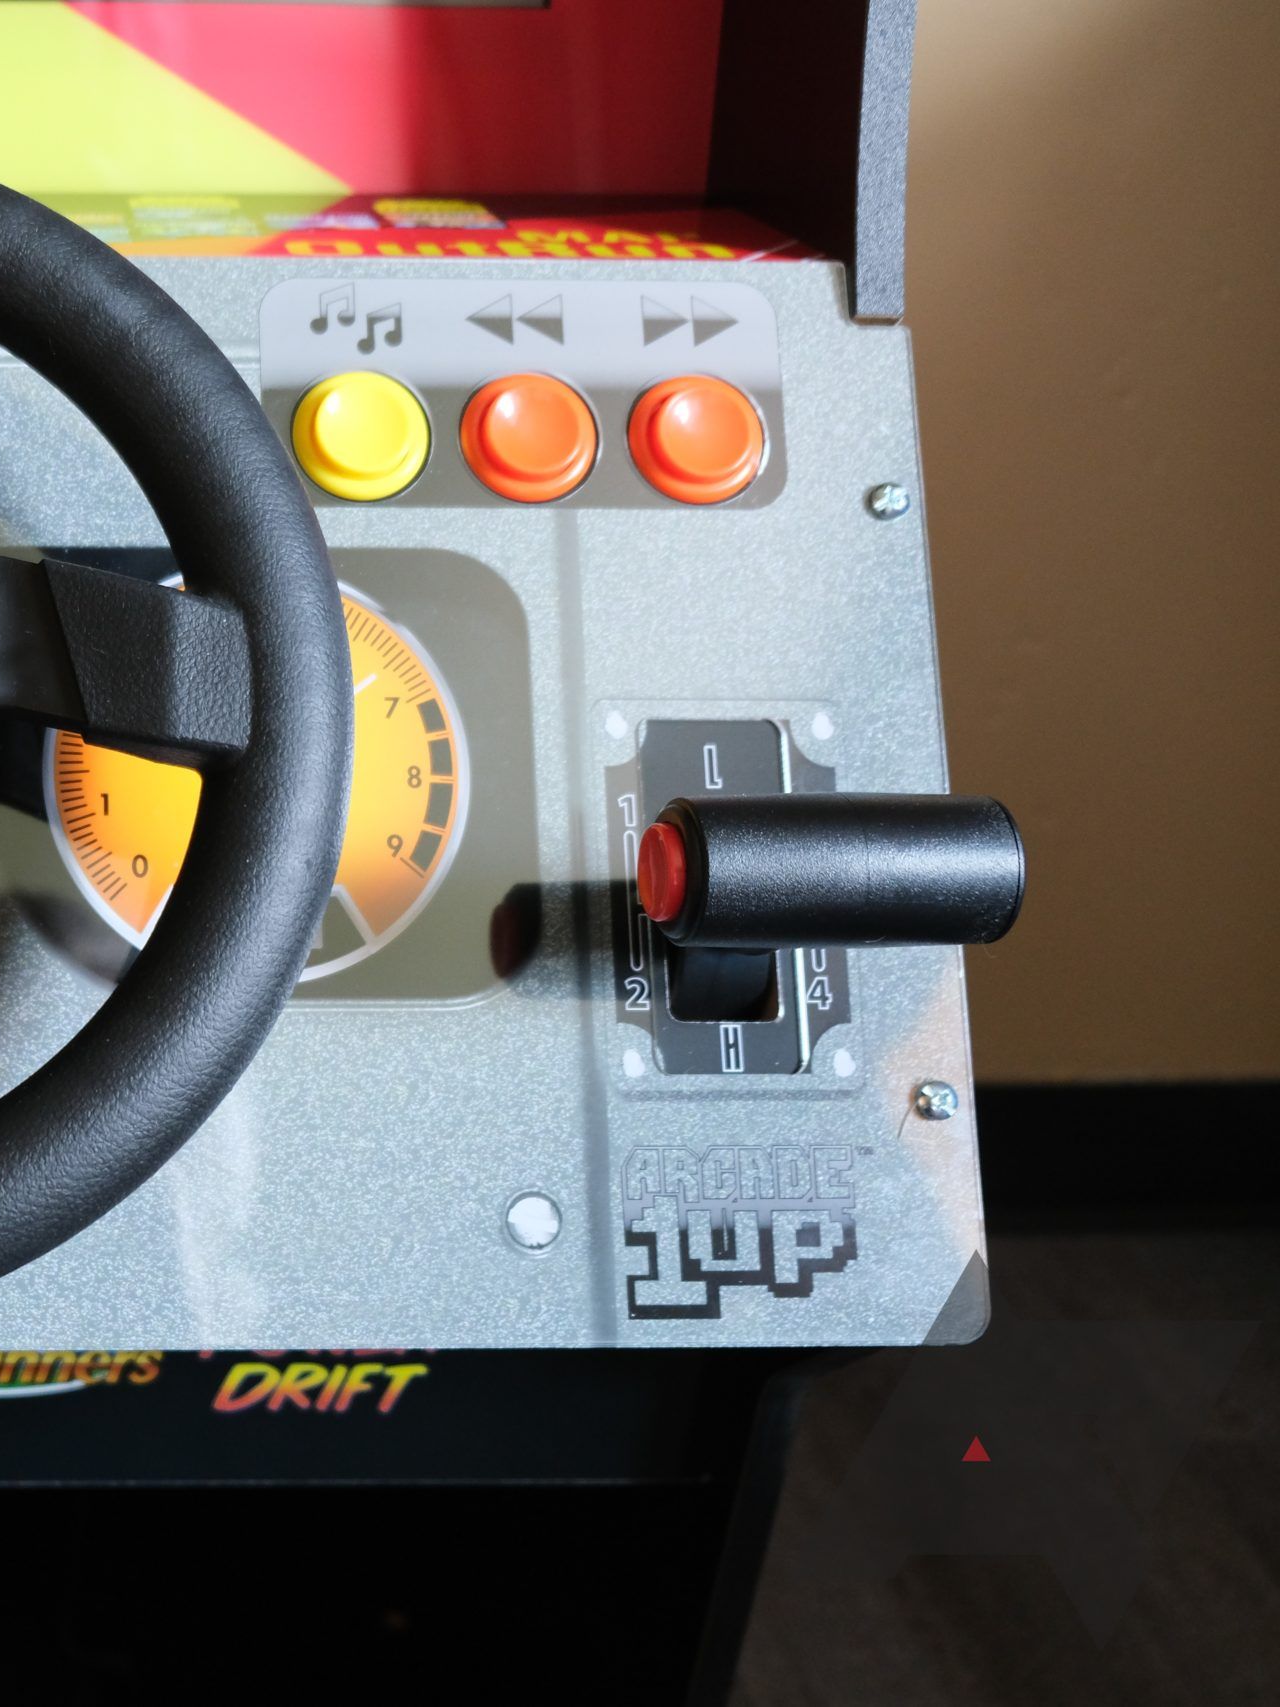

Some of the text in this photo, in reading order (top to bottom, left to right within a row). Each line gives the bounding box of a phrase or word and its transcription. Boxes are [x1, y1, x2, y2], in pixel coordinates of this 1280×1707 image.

[384, 697, 400, 719] 7
[407, 765, 422, 789] 8
[100, 793, 110, 816] 1
[618, 794, 637, 827] 1
[386, 834, 404, 858] 9
[131, 854, 149, 878] 0
[624, 977, 650, 1010] 2
[807, 976, 833, 1010] 4
[720, 1024, 744, 1073] H
[621, 1145, 856, 1203] ARCADE
[211, 1362, 429, 1413] DRIFT
